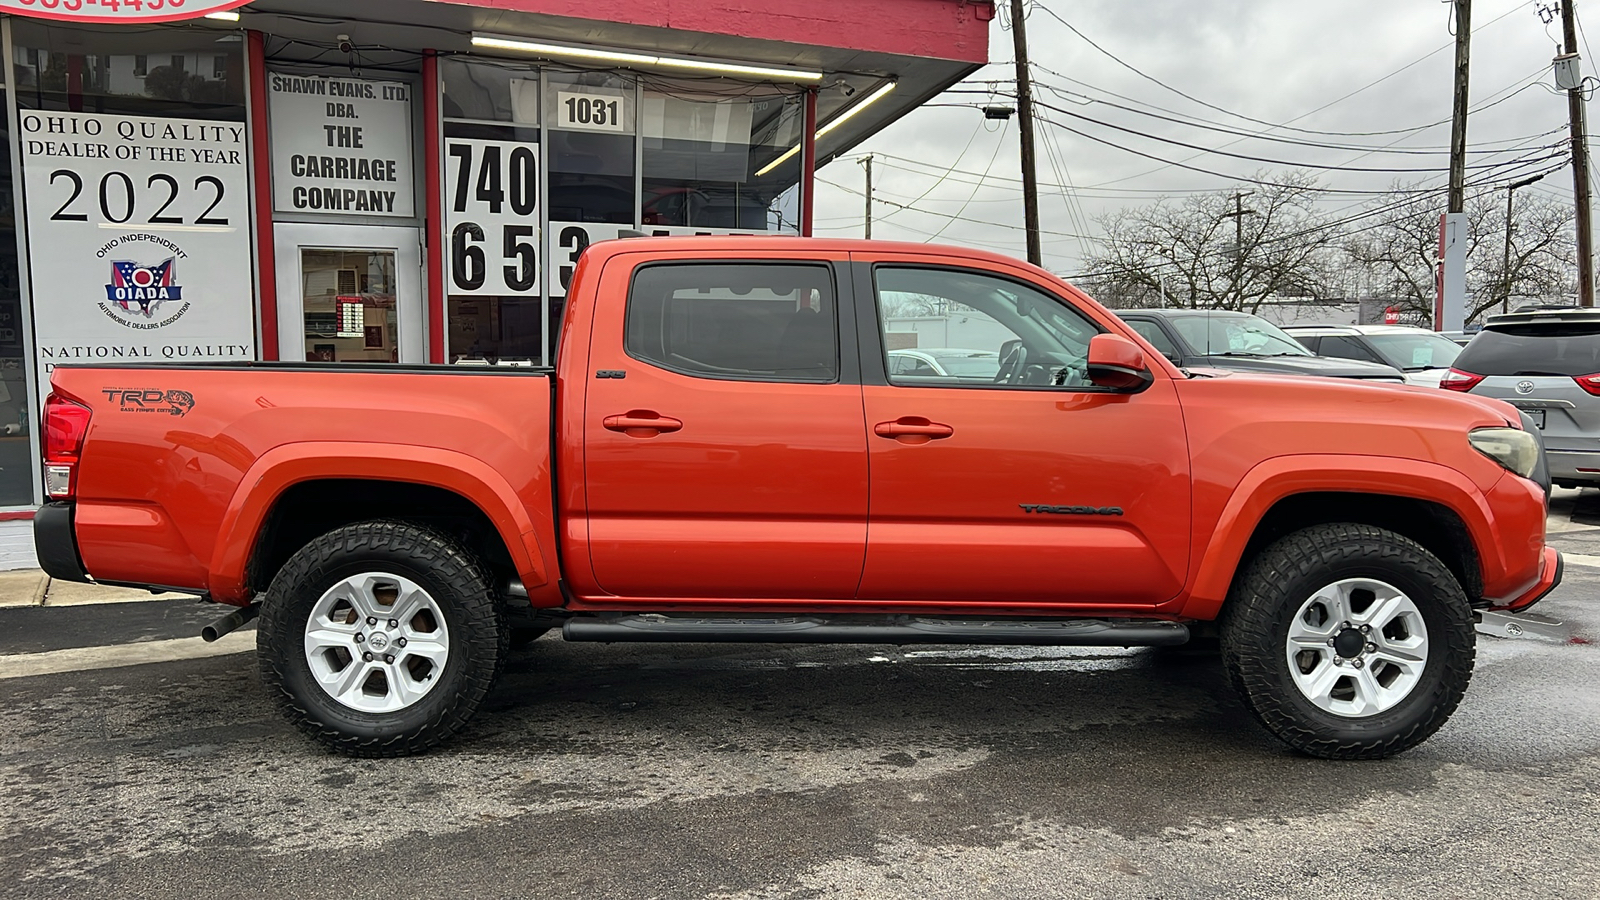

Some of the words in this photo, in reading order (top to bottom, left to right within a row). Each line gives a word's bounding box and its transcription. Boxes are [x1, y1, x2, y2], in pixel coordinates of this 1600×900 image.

[272, 76, 326, 95] SHAWN
[329, 81, 376, 99] EVANS.
[382, 86, 409, 102] LTD.
[326, 102, 359, 119] DBA.
[565, 97, 618, 126] 1031
[23, 115, 102, 136] OHIO
[117, 121, 243, 143] QUALITY
[323, 124, 363, 149] THE
[28, 140, 110, 159] DEALER
[115, 144, 141, 161] OF
[146, 147, 186, 163] THE
[190, 148, 242, 165] YEAR
[290, 154, 397, 182] CARRIAGE
[449, 143, 536, 216] 740
[49, 169, 229, 225] 2022
[292, 186, 396, 212] COMPANY
[96, 239, 119, 258] OHIO
[119, 233, 188, 259] INDEPENDENT
[115, 287, 170, 300] OIADA
[97, 302, 131, 328] AUTOMOBILE
[132, 322, 159, 330] DEALERS
[160, 301, 191, 328] ASSOCIATION
[41, 346, 152, 358] NATIONAL
[161, 345, 249, 359] QUALITY
[102, 389, 164, 407] TRD
[1019, 503, 1124, 516] TACOMA
